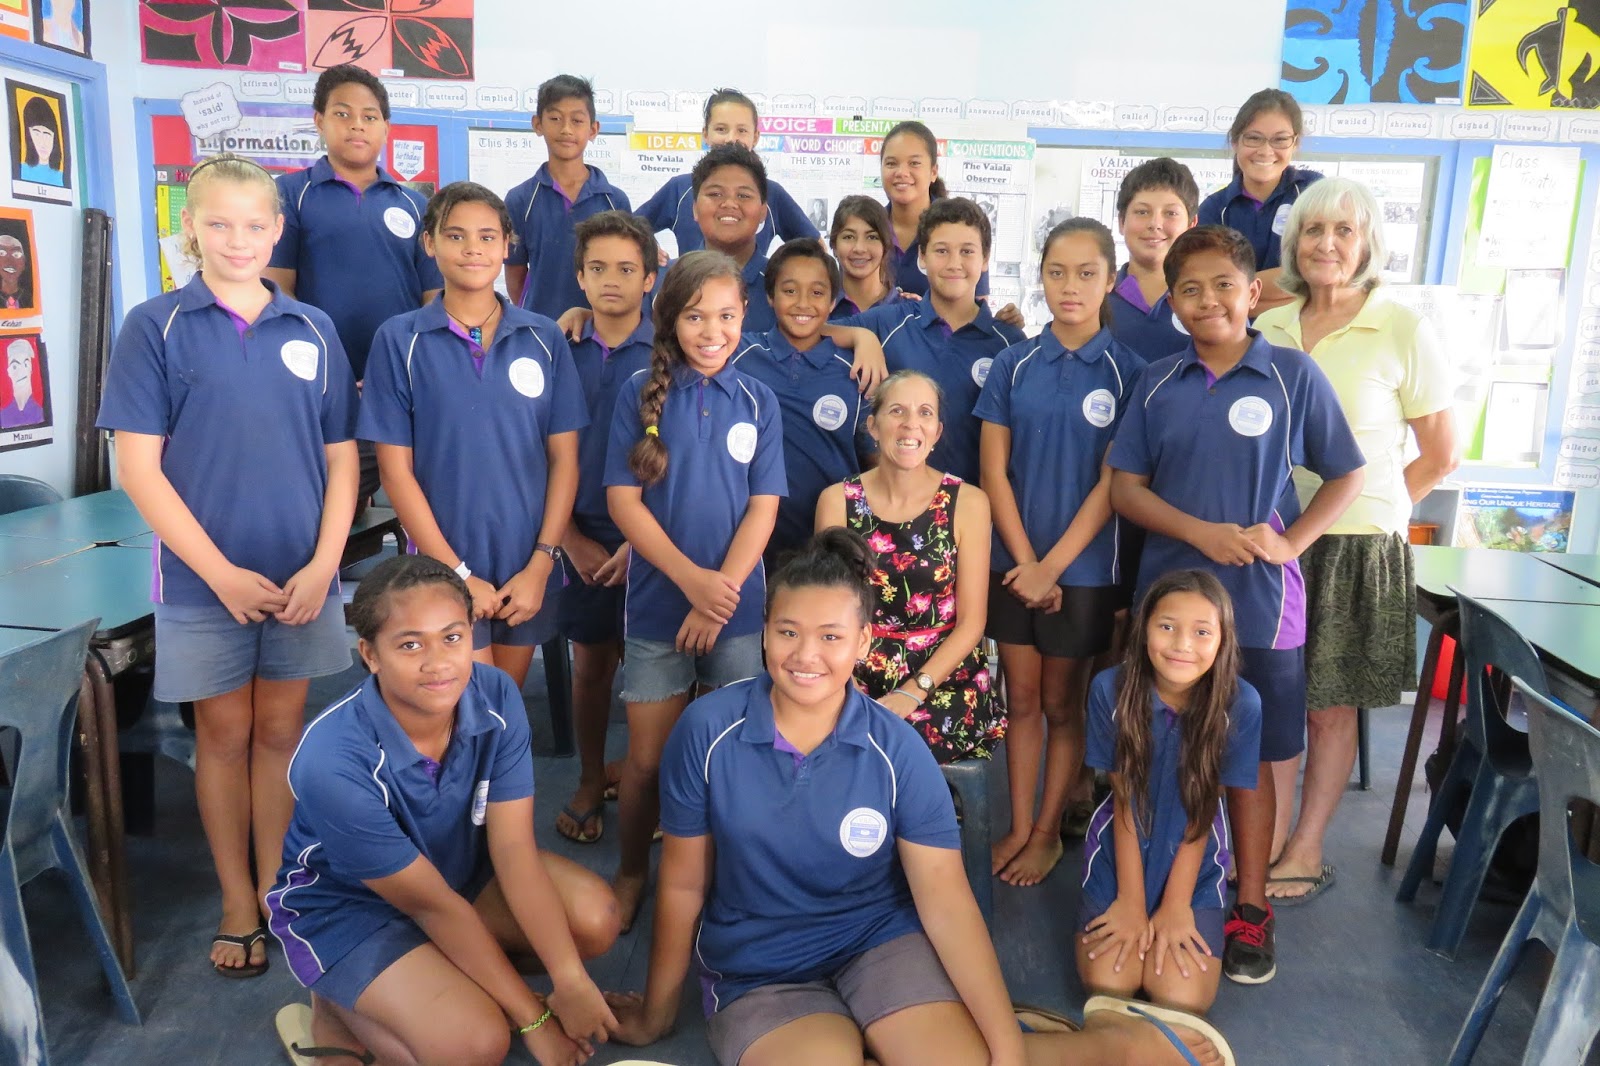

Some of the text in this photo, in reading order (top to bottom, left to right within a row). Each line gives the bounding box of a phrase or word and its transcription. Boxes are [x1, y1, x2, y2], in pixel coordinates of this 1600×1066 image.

[428, 93, 465, 101] muttered
[480, 94, 513, 103] implied
[630, 99, 666, 107] bellowed
[921, 105, 959, 113] asserted
[1015, 108, 1051, 117] guessed
[1121, 112, 1149, 120] called
[196, 122, 209, 131] why
[210, 118, 221, 127] not
[761, 118, 817, 132] VOICE
[1390, 121, 1427, 129] shrieked
[1458, 121, 1489, 130] sighed
[1507, 124, 1547, 133] squawked
[1572, 127, 1600, 135] scream
[478, 137, 502, 149] This
[647, 135, 697, 149] IDEAS
[790, 138, 821, 151] WORD
[824, 138, 863, 152] CHOICE
[953, 143, 1026, 158] CONVENTIONS
[637, 154, 684, 163] The Vaiala
[791, 156, 851, 166] THE VBS STAR
[1500, 151, 1540, 169] Class
[640, 164, 681, 173] Observer
[963, 161, 1011, 172] The Vaiala
[1199, 170, 1216, 178] VBS
[965, 174, 1007, 184] Observer
[13, 432, 33, 442] Manu
[1565, 443, 1598, 453] alleged
